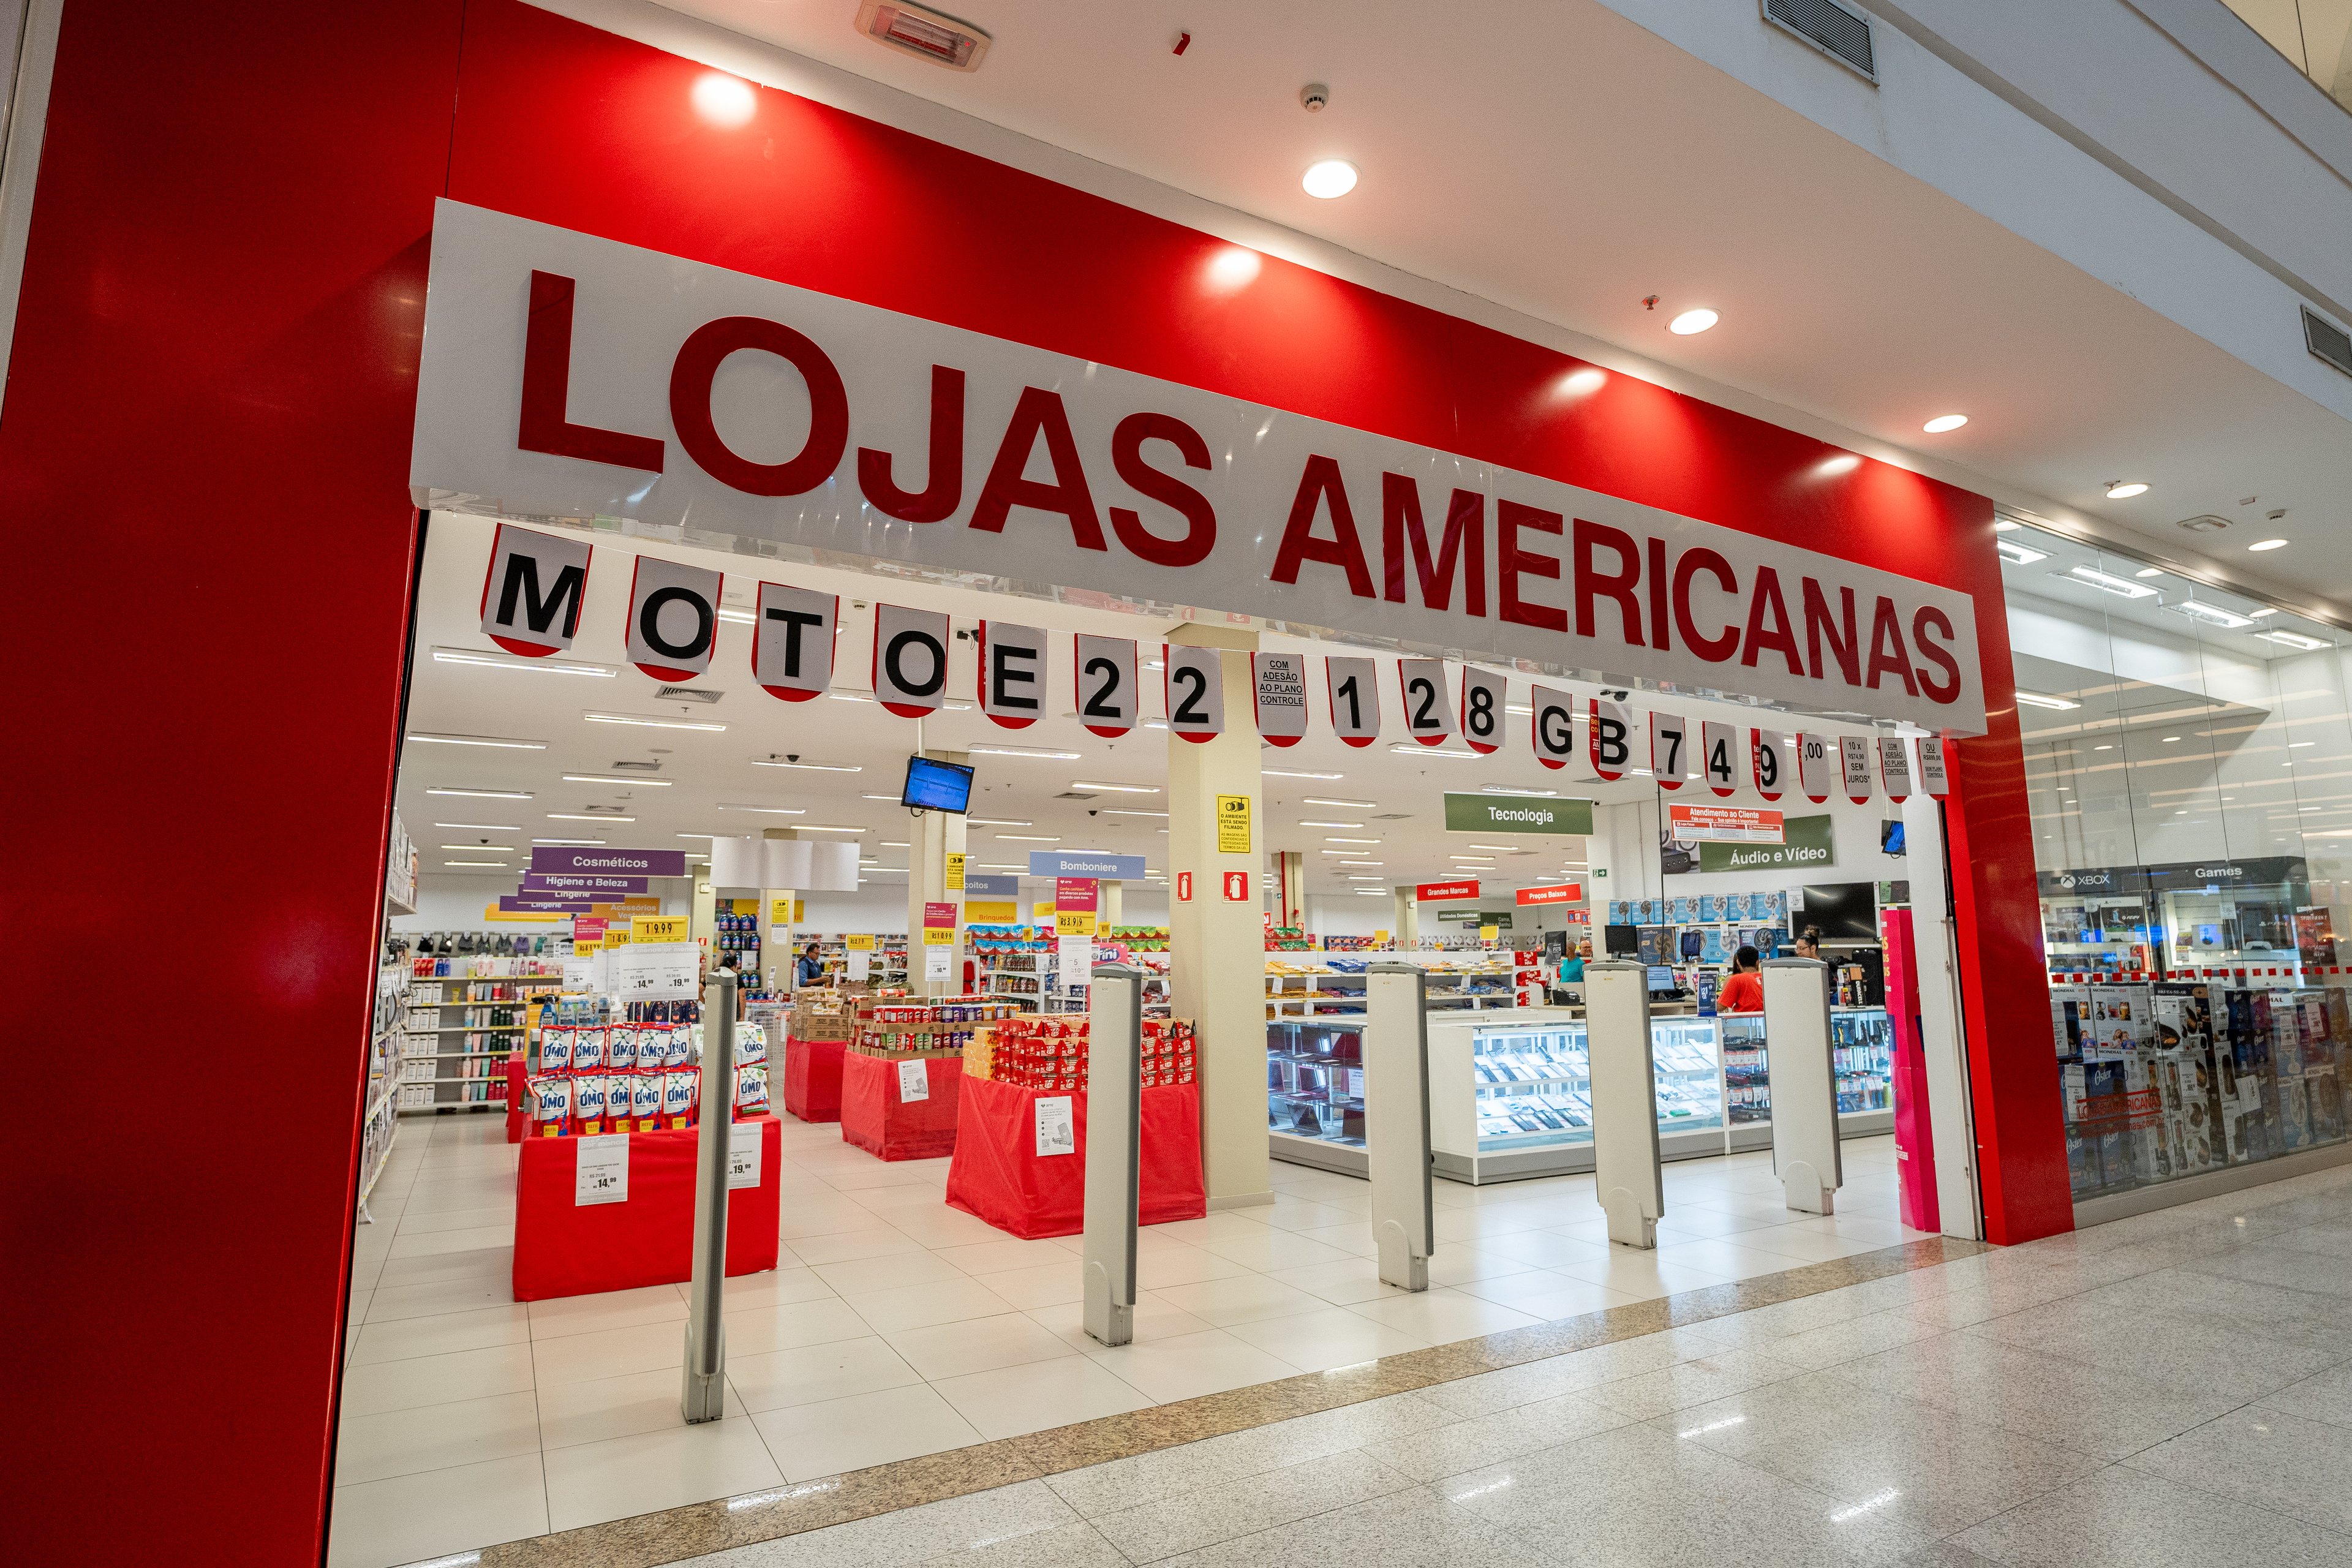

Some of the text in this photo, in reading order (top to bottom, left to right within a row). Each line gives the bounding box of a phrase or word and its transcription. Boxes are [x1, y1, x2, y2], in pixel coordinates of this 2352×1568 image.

[518, 268, 1962, 706] LOJAS AMERICANAS
[1263, 671, 1297, 680] ADESÃO
[1275, 684, 1302, 693] PLANO
[1261, 696, 1303, 704] CONTROLE
[1849, 741, 1856, 750] 10
[1488, 806, 1553, 825] Tecnologia
[1690, 808, 1728, 816] Atendimento
[1738, 810, 1759, 818] Cliente
[1730, 847, 1826, 865] Áudio e Vídeo
[573, 856, 648, 868] Cosméticos
[1060, 861, 1117, 872] Bomboniere
[2195, 867, 2242, 878] Games
[546, 876, 584, 886] Higiene
[595, 878, 628, 887] Beleza
[2078, 875, 2110, 886] XBOX
[611, 903, 657, 912] Acessórios
[545, 1046, 567, 1057] OMO
[576, 1046, 598, 1057] OMO
[613, 1044, 636, 1057] OMO
[641, 1046, 664, 1058] OMO
[744, 1043, 763, 1053] OMO
[2094, 1069, 2111, 1085] Oster
[741, 1082, 761, 1095] OMO
[541, 1095, 565, 1109] OMO
[580, 1093, 604, 1106] OMO
[611, 1091, 630, 1104] OM
[635, 1091, 658, 1104] OMO
